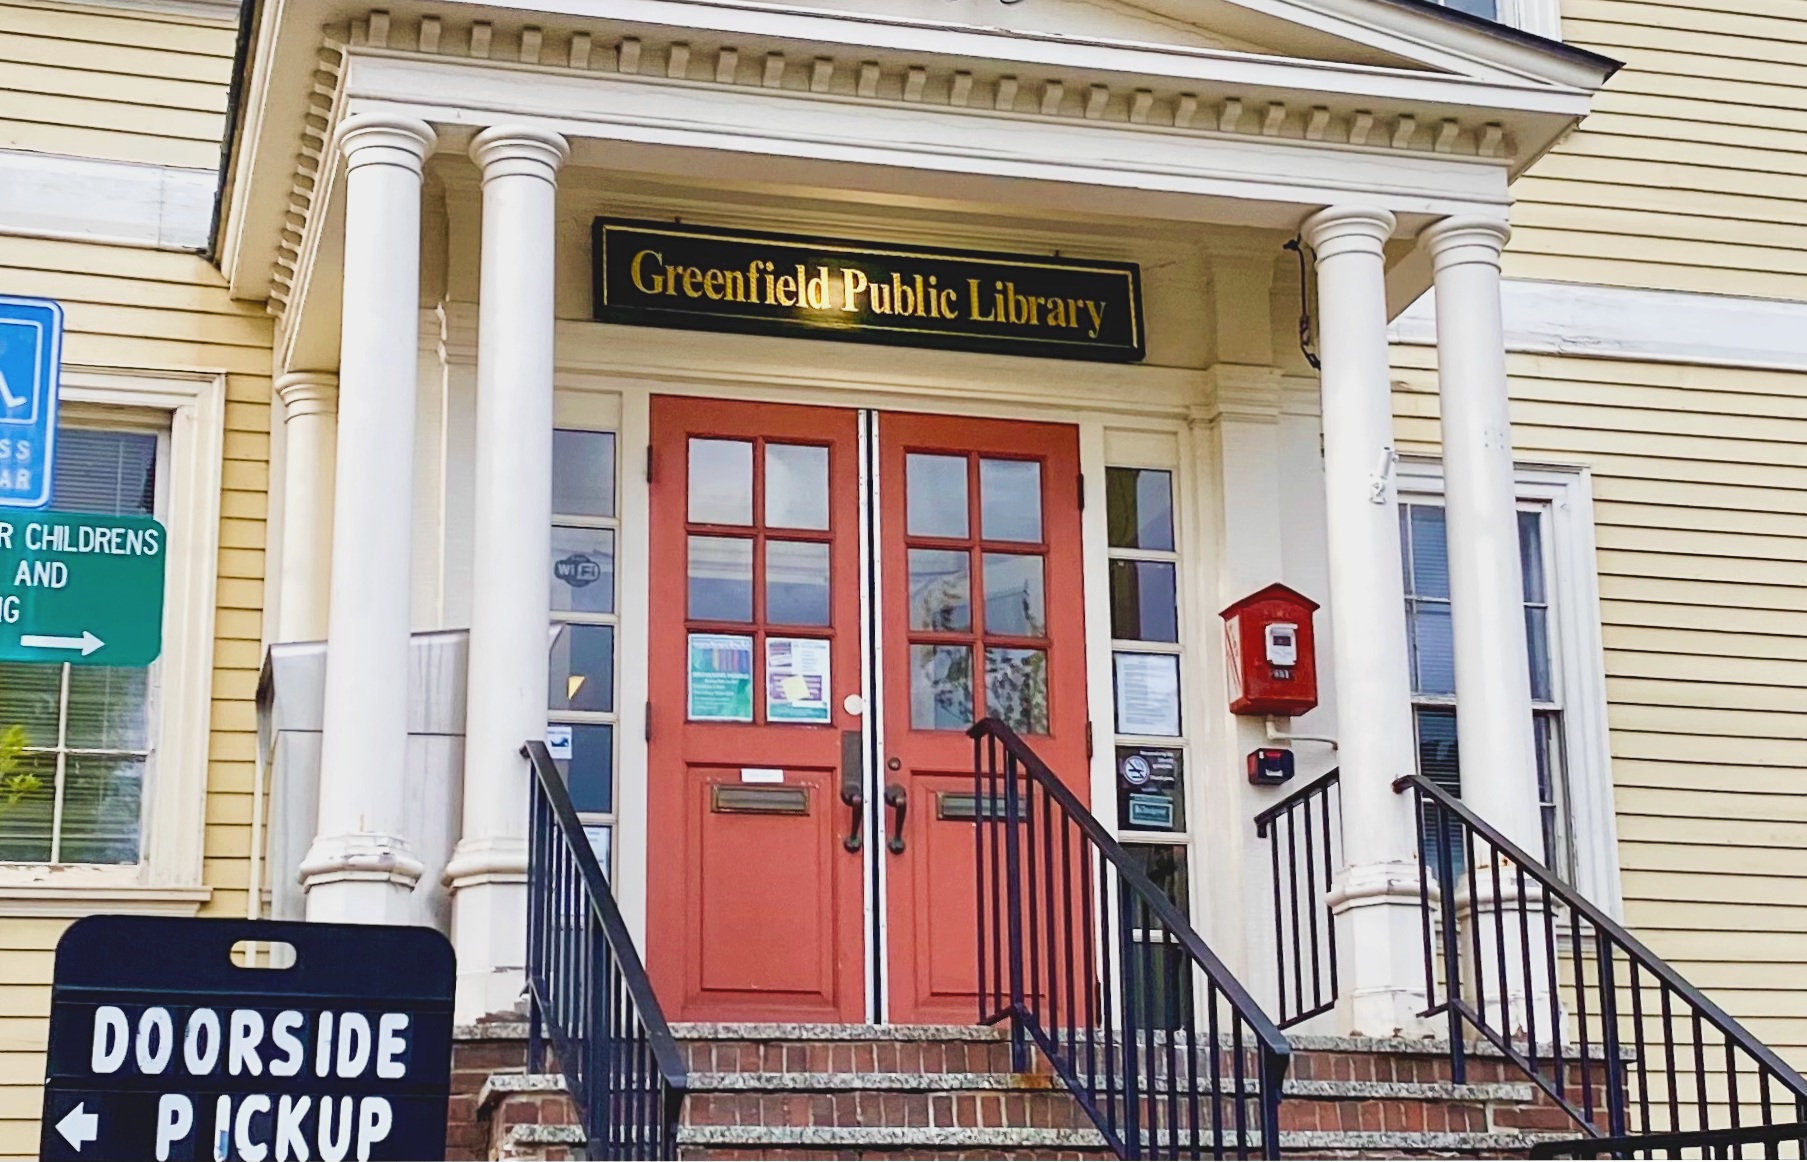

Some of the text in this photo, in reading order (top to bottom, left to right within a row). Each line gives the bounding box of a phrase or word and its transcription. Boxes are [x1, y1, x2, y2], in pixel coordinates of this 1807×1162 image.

[631, 249, 1107, 339] Greenfield Public Library
[25, 522, 160, 556] CHILDRENS
[13, 559, 69, 589] AND
[91, 1005, 410, 1079] DOORSIDE
[155, 1093, 393, 1161] PICKUP
